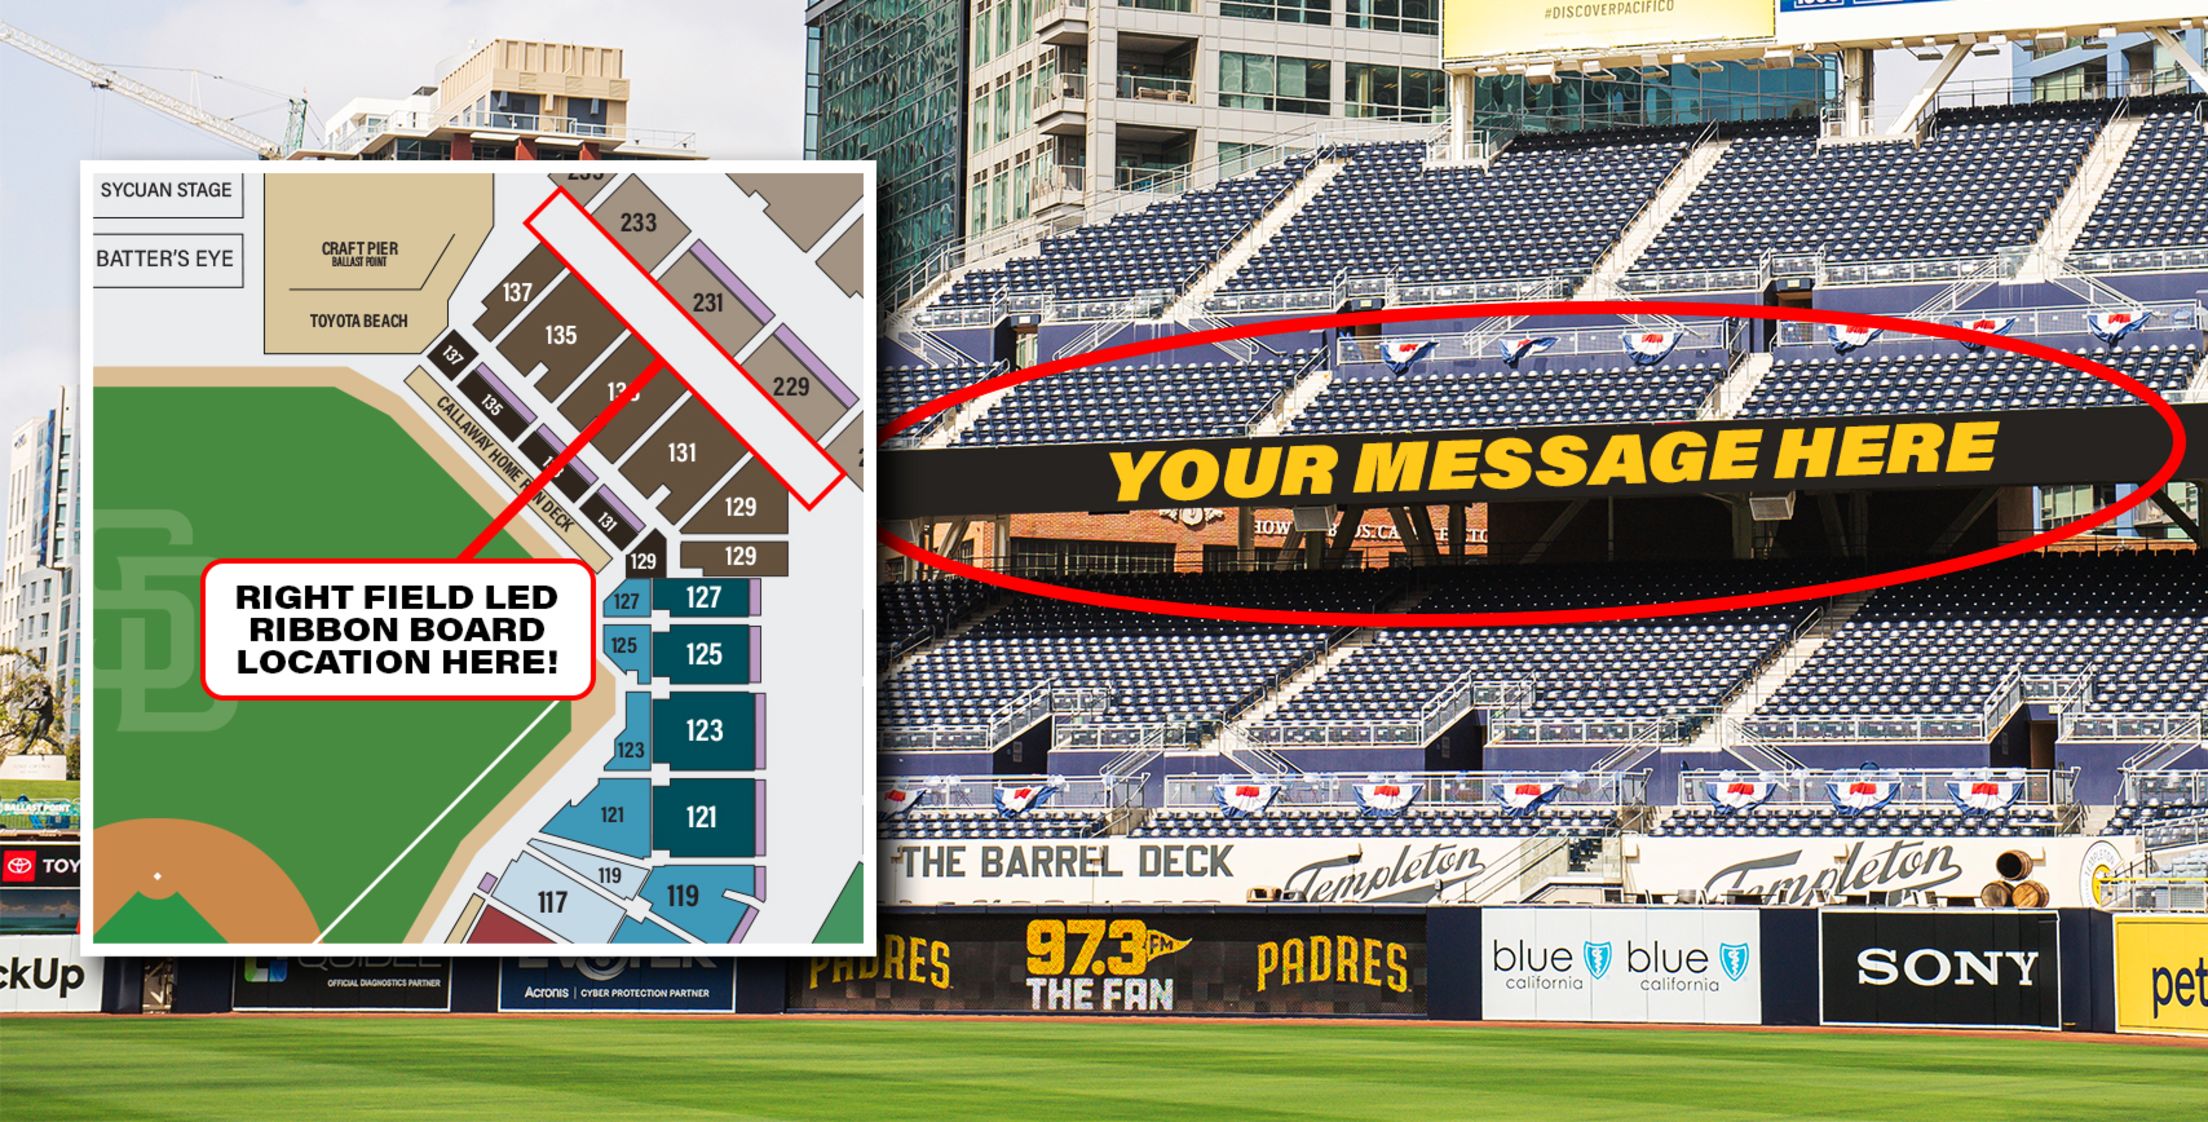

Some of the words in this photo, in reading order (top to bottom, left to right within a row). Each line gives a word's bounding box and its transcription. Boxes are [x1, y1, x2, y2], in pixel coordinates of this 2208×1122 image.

[1544, 0, 1675, 20] #DISCOVERPACIFICO
[899, 844, 966, 878] THE
[981, 845, 1123, 878] BARREL
[1139, 844, 1234, 878] DECK
[1285, 843, 1486, 902] Templeton
[1026, 919, 1147, 976] 97.3
[1150, 934, 1174, 955] FM
[1257, 934, 1409, 993] PADRES
[1493, 939, 1573, 972] blue
[1627, 940, 1709, 974] blue
[327, 979, 359, 988] OFFICIAL
[360, 979, 407, 988] DIAGNOSTICS
[408, 979, 441, 988] PARTNER
[1505, 975, 1584, 990] california
[1640, 976, 1720, 993] california
[1857, 947, 2039, 988] SONY
[524, 986, 570, 998] Acronis
[580, 988, 610, 998] CYBER
[611, 988, 668, 998] PROTECTION
[669, 988, 710, 998] PARTNER
[1026, 977, 1094, 1011] THE
[1102, 977, 1174, 1011] FAN
